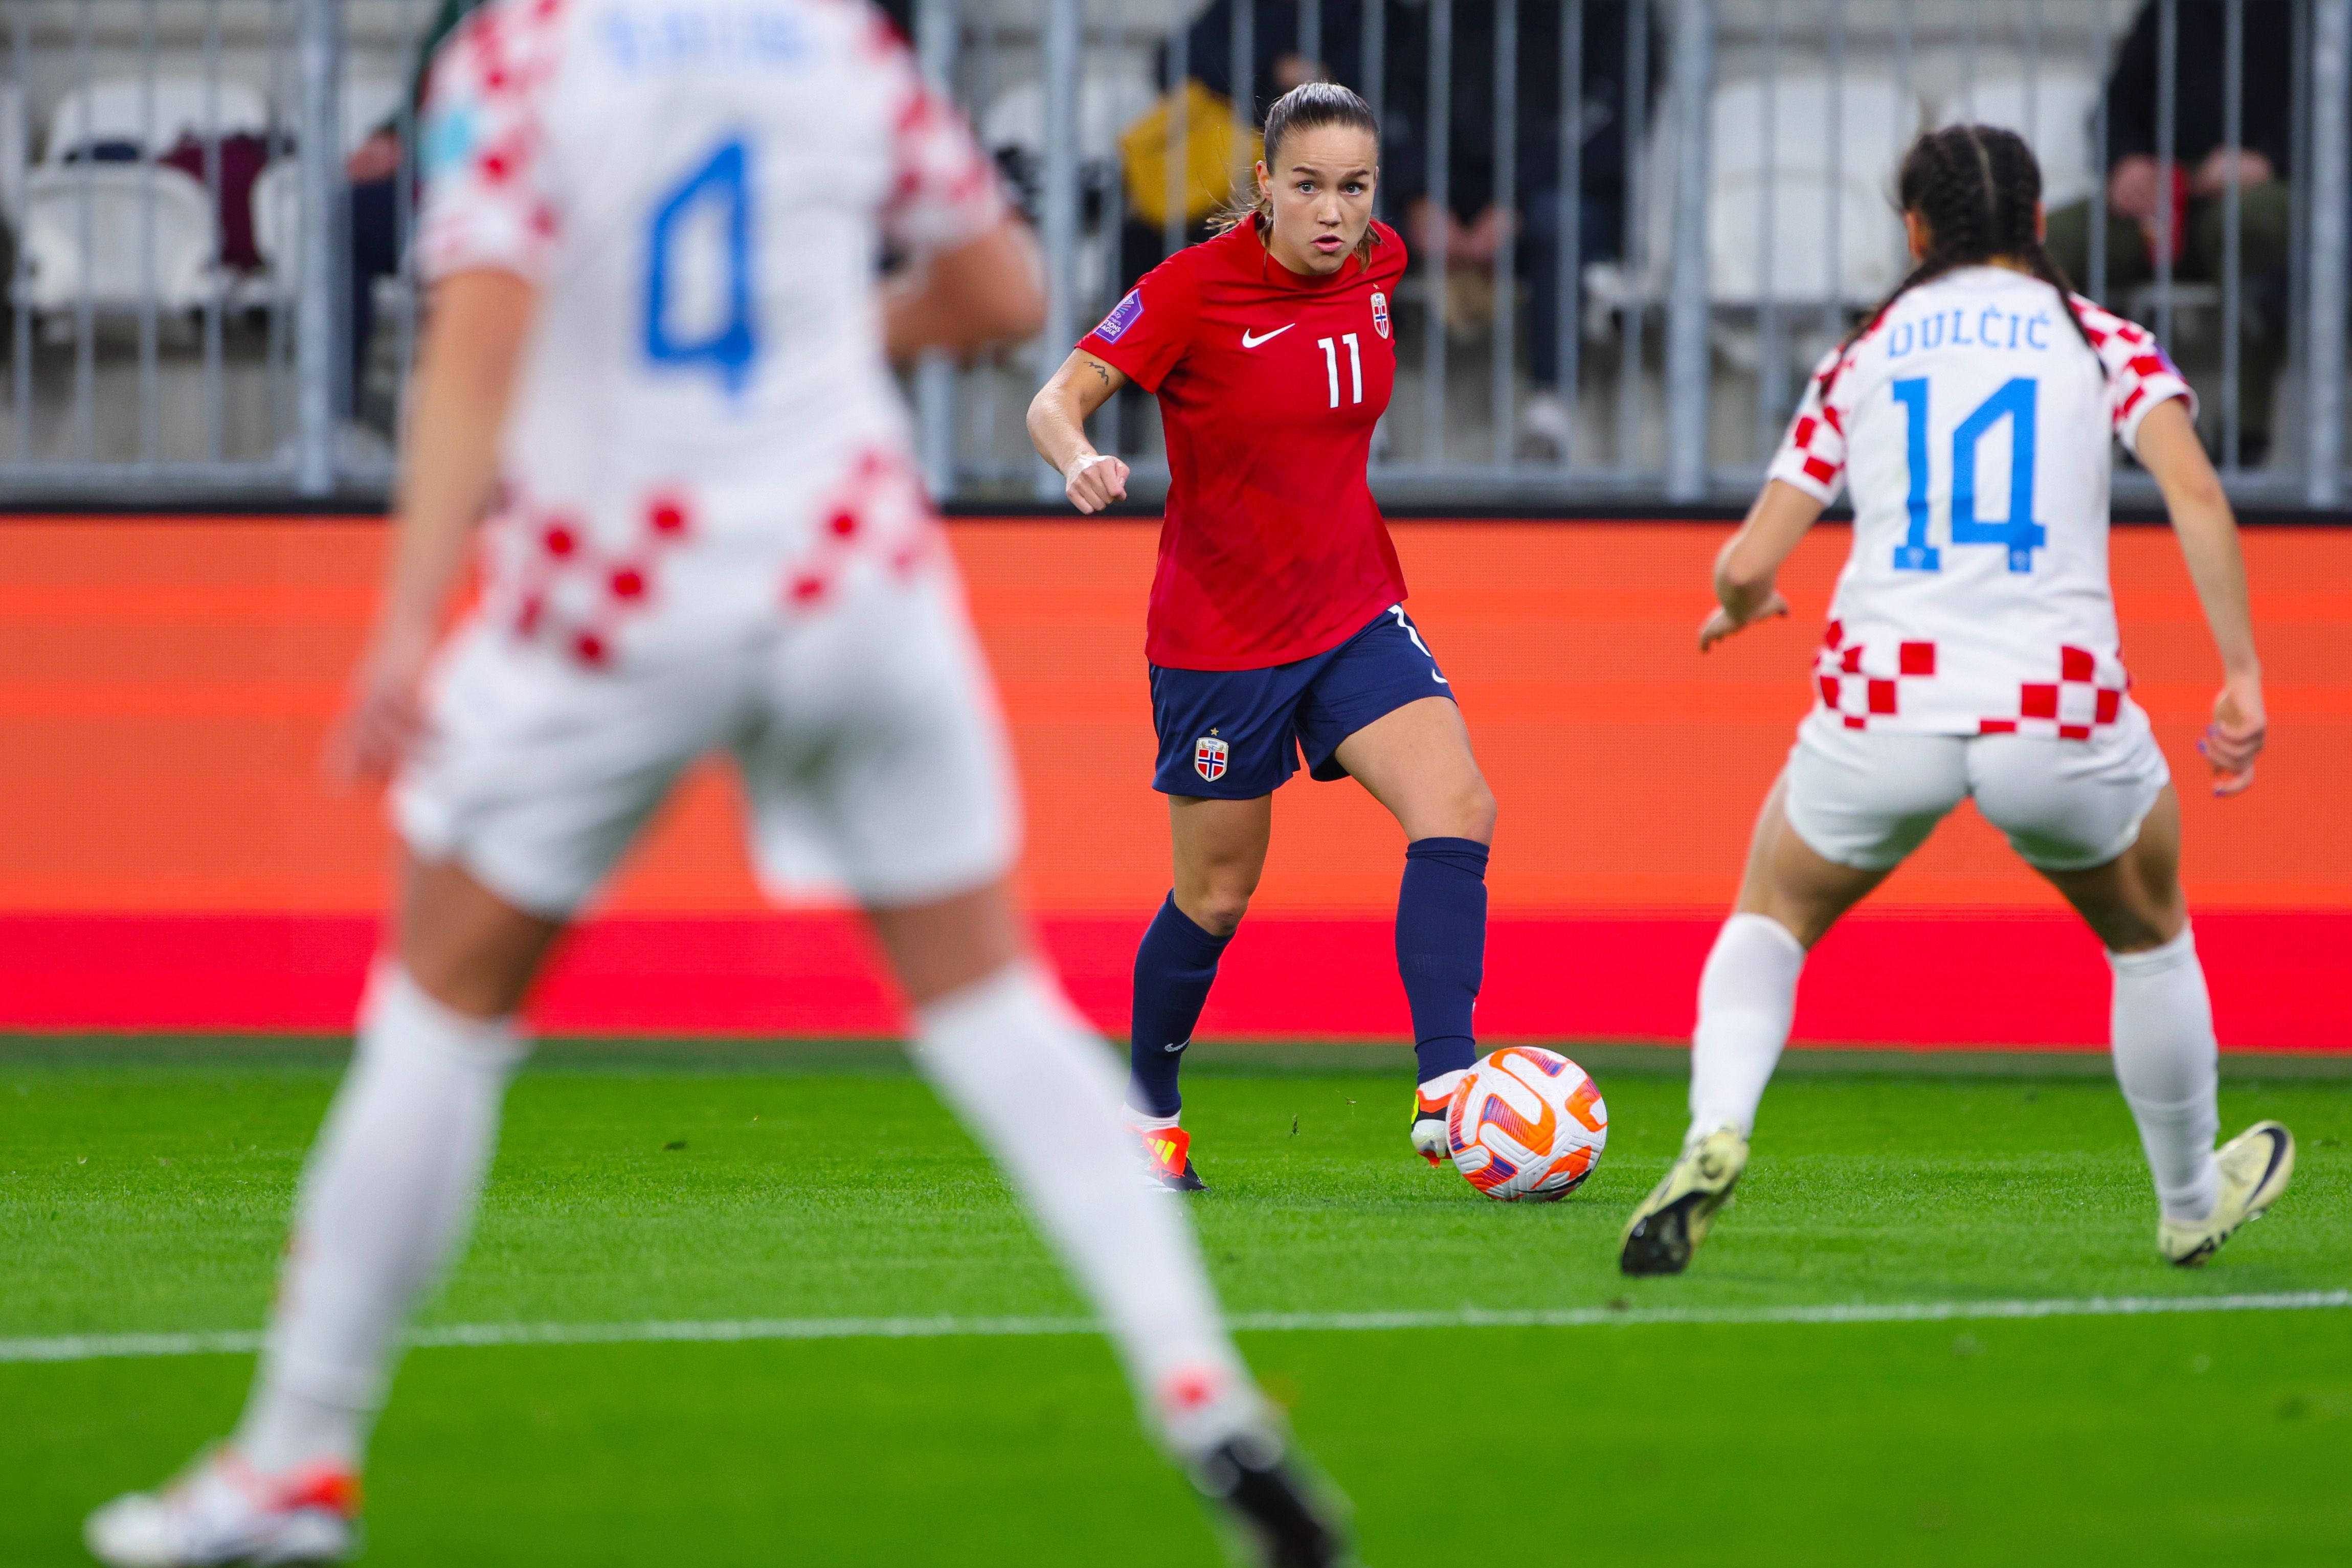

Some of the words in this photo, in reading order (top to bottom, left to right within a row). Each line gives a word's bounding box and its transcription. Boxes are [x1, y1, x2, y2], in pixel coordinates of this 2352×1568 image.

[642, 132, 759, 404] 4
[1100, 323, 1117, 336] EAGUE
[1105, 319, 1121, 332] TIONS
[1317, 332, 1362, 408] 11
[1893, 377, 2046, 572] 14
